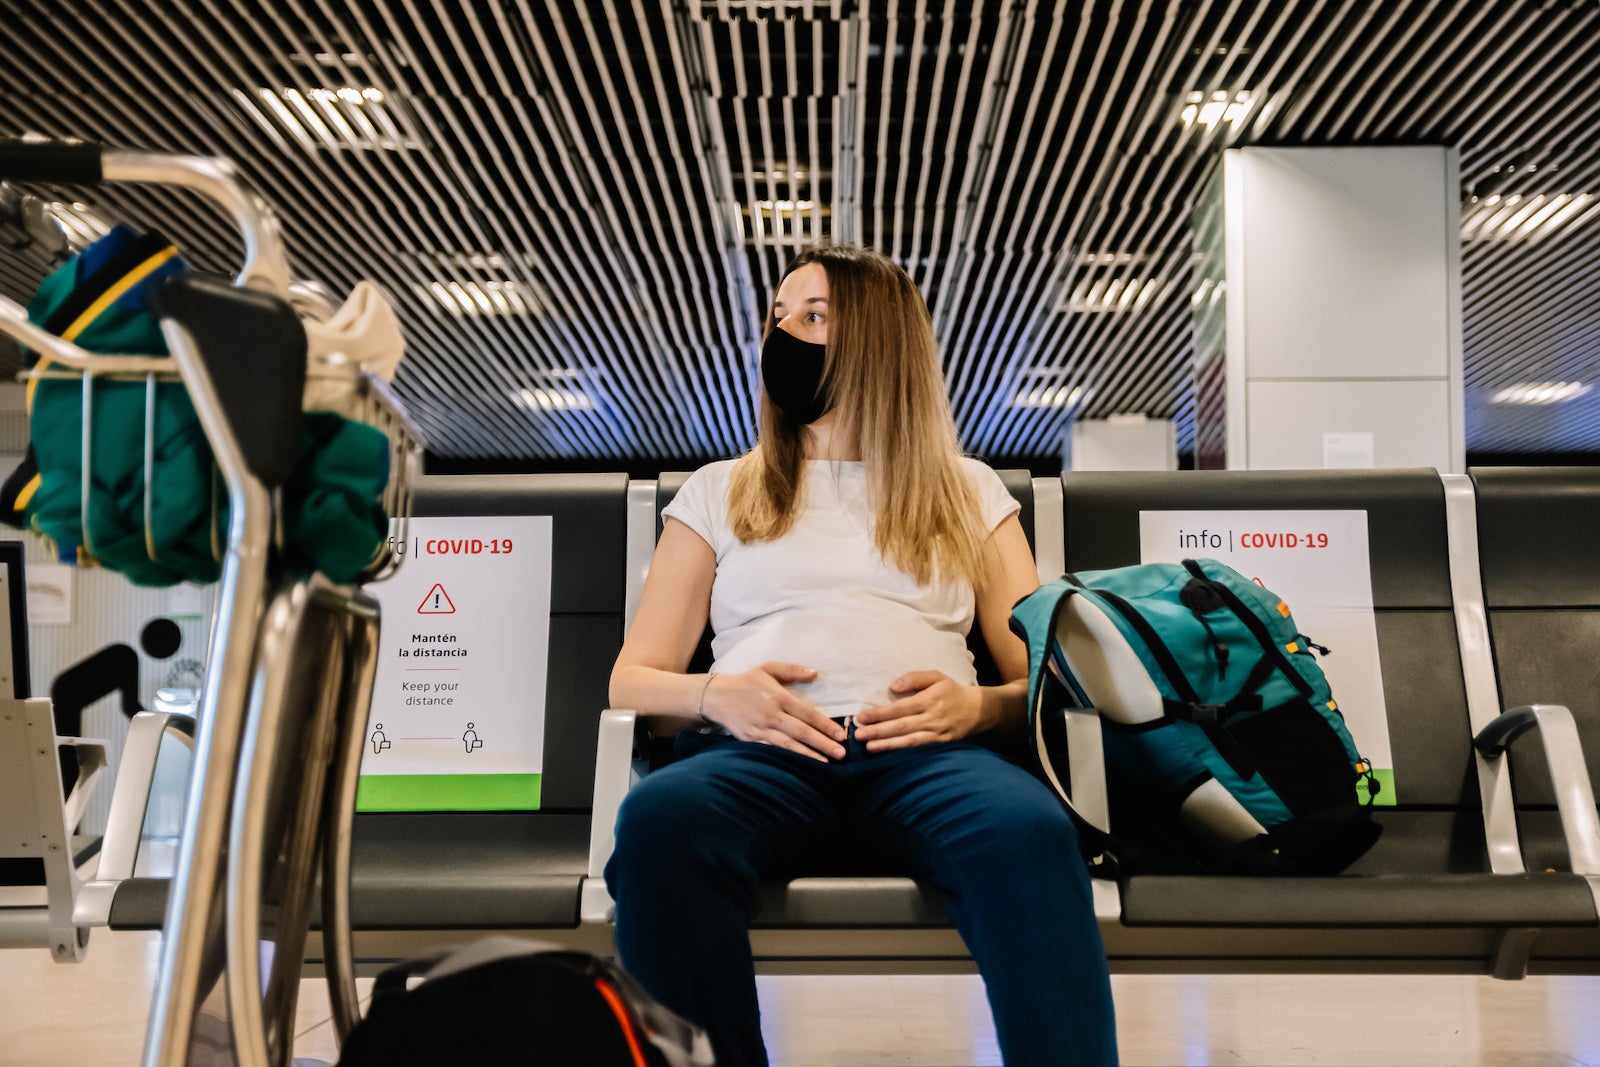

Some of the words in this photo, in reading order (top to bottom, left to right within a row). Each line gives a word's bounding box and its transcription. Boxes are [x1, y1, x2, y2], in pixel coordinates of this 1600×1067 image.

[1179, 529, 1222, 549] info
[1240, 532, 1329, 549] COVID-19
[426, 538, 513, 555] COVID-19
[411, 633, 457, 643] Mantén
[398, 648, 409, 658] la
[413, 648, 468, 657] distancia
[402, 681, 431, 693] Keep
[434, 682, 459, 693] your
[405, 696, 454, 706] distance
